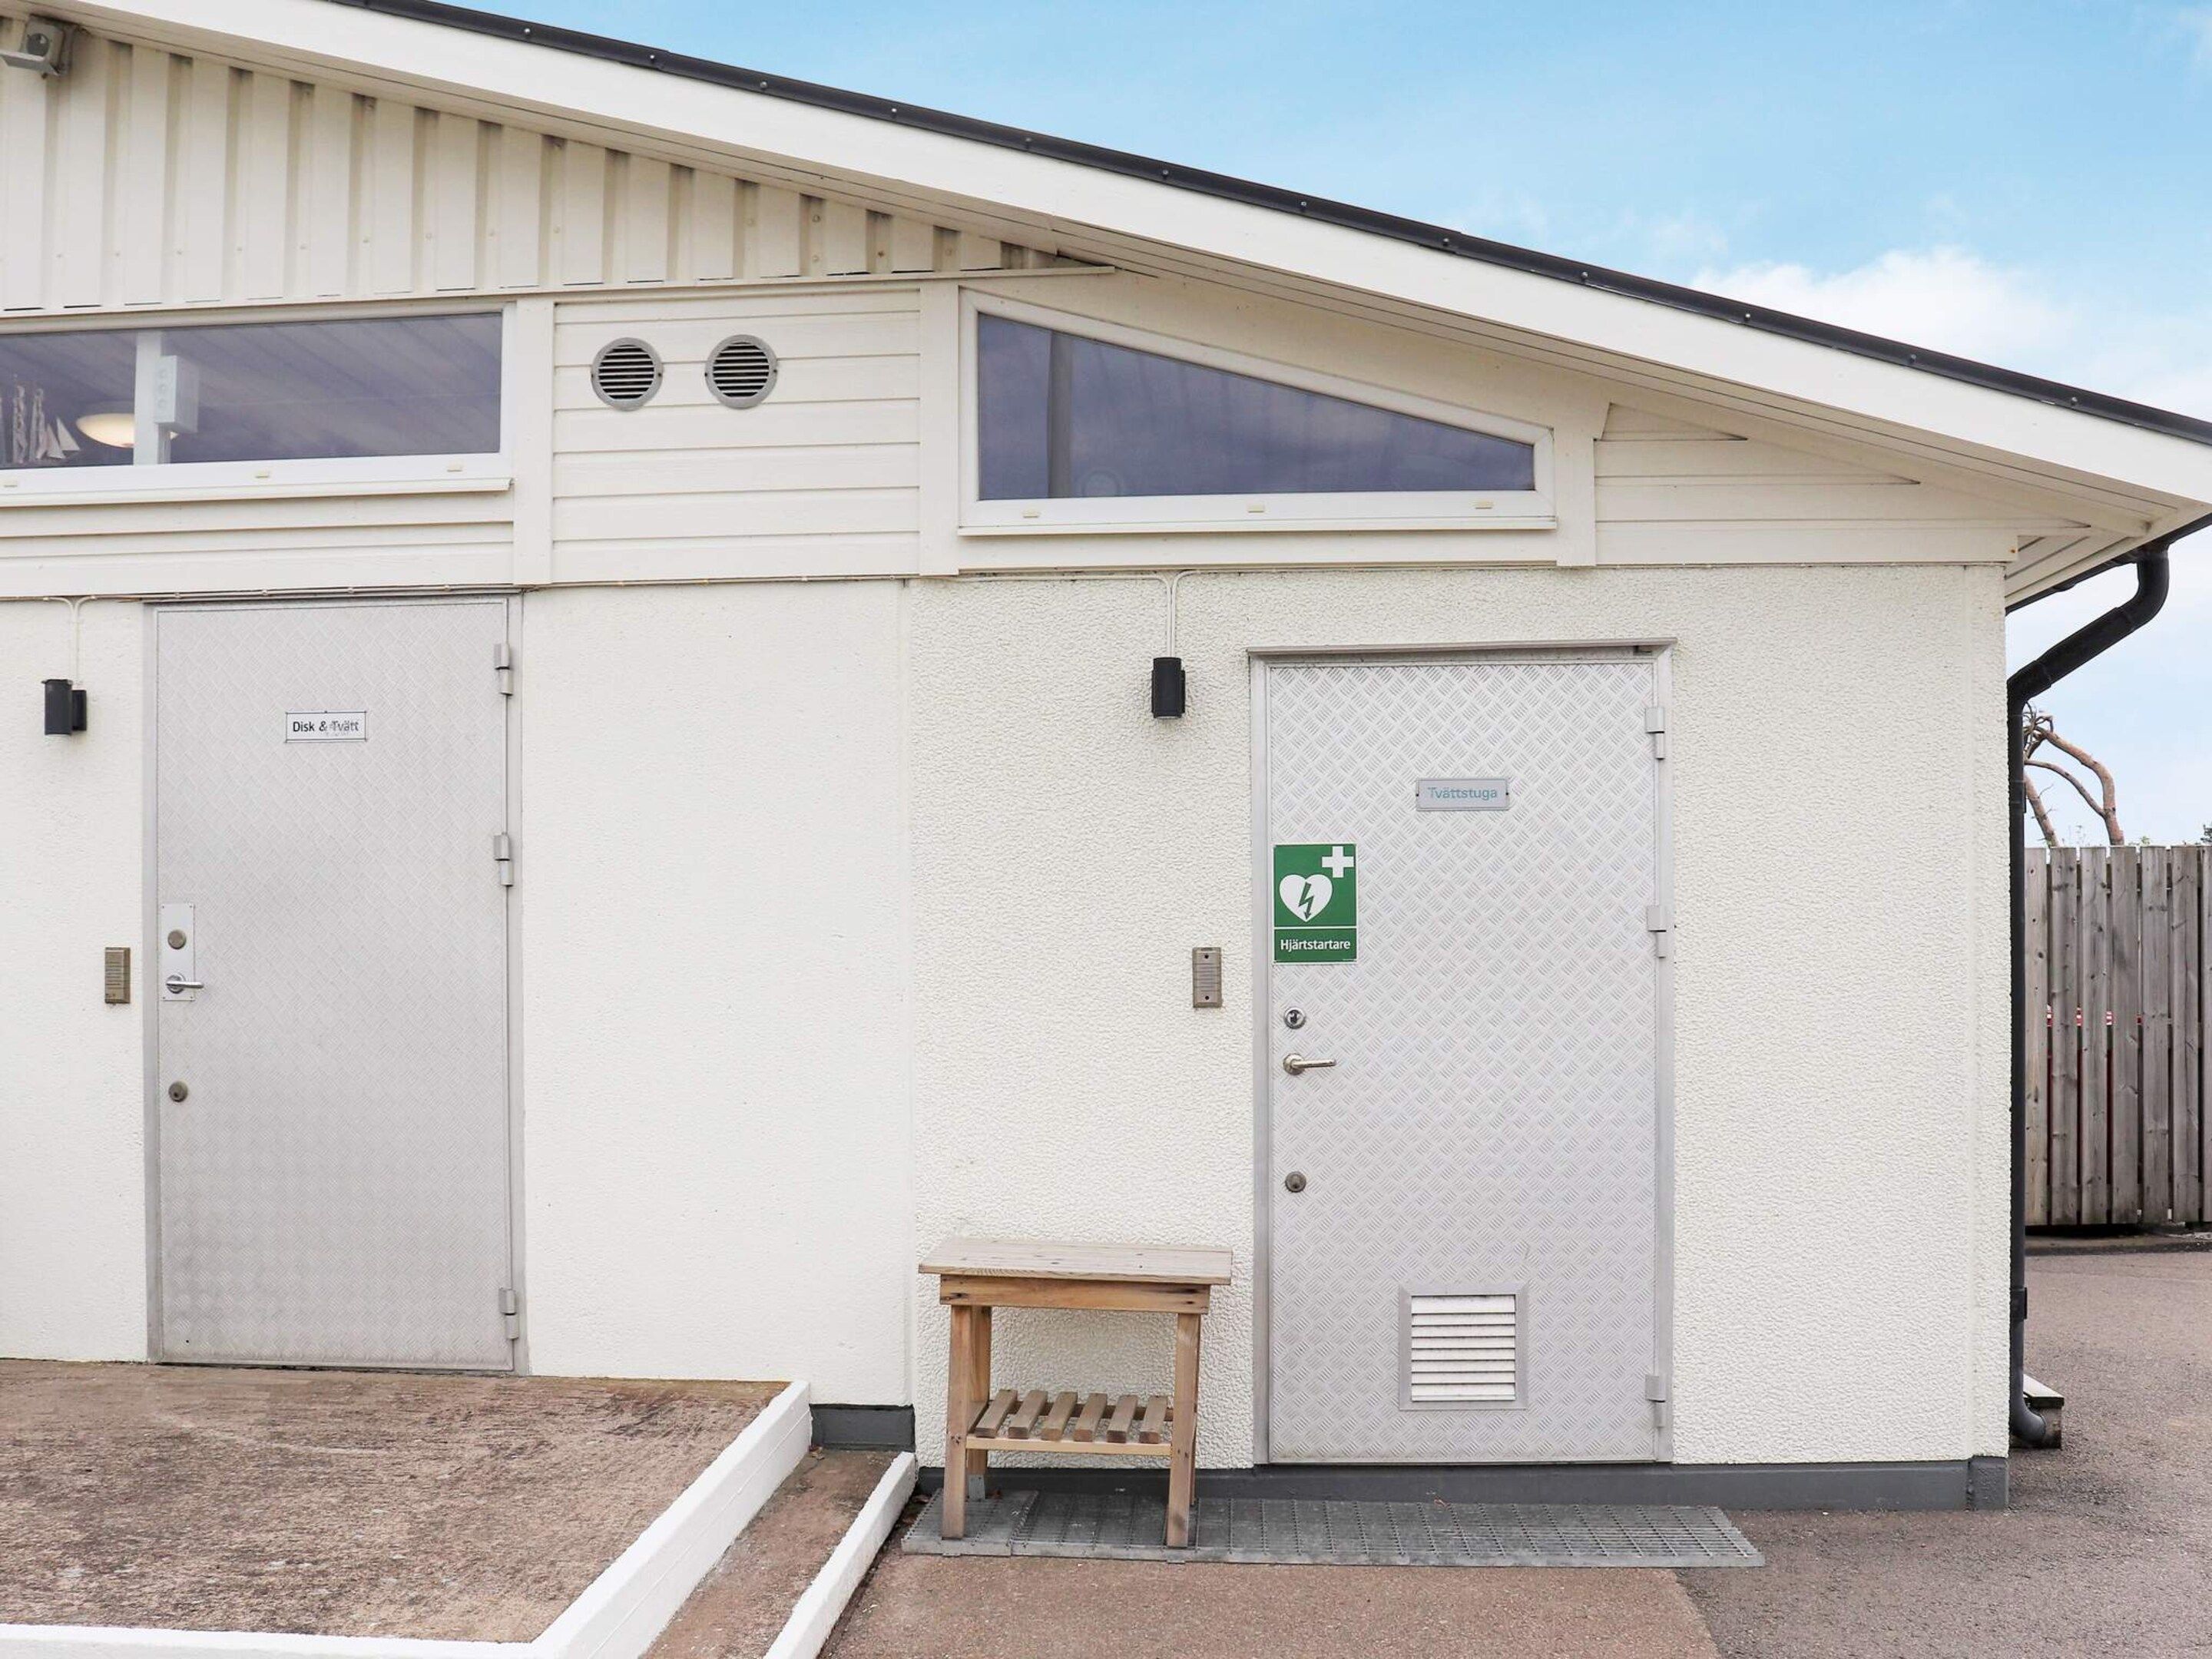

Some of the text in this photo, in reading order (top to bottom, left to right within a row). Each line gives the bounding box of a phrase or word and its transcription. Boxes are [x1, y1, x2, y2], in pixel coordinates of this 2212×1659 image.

[293, 720, 359, 732] Disk & Tvätt
[1428, 786, 1497, 801] Tvättstuga
[1280, 939, 1351, 952] Hjärtstartare
